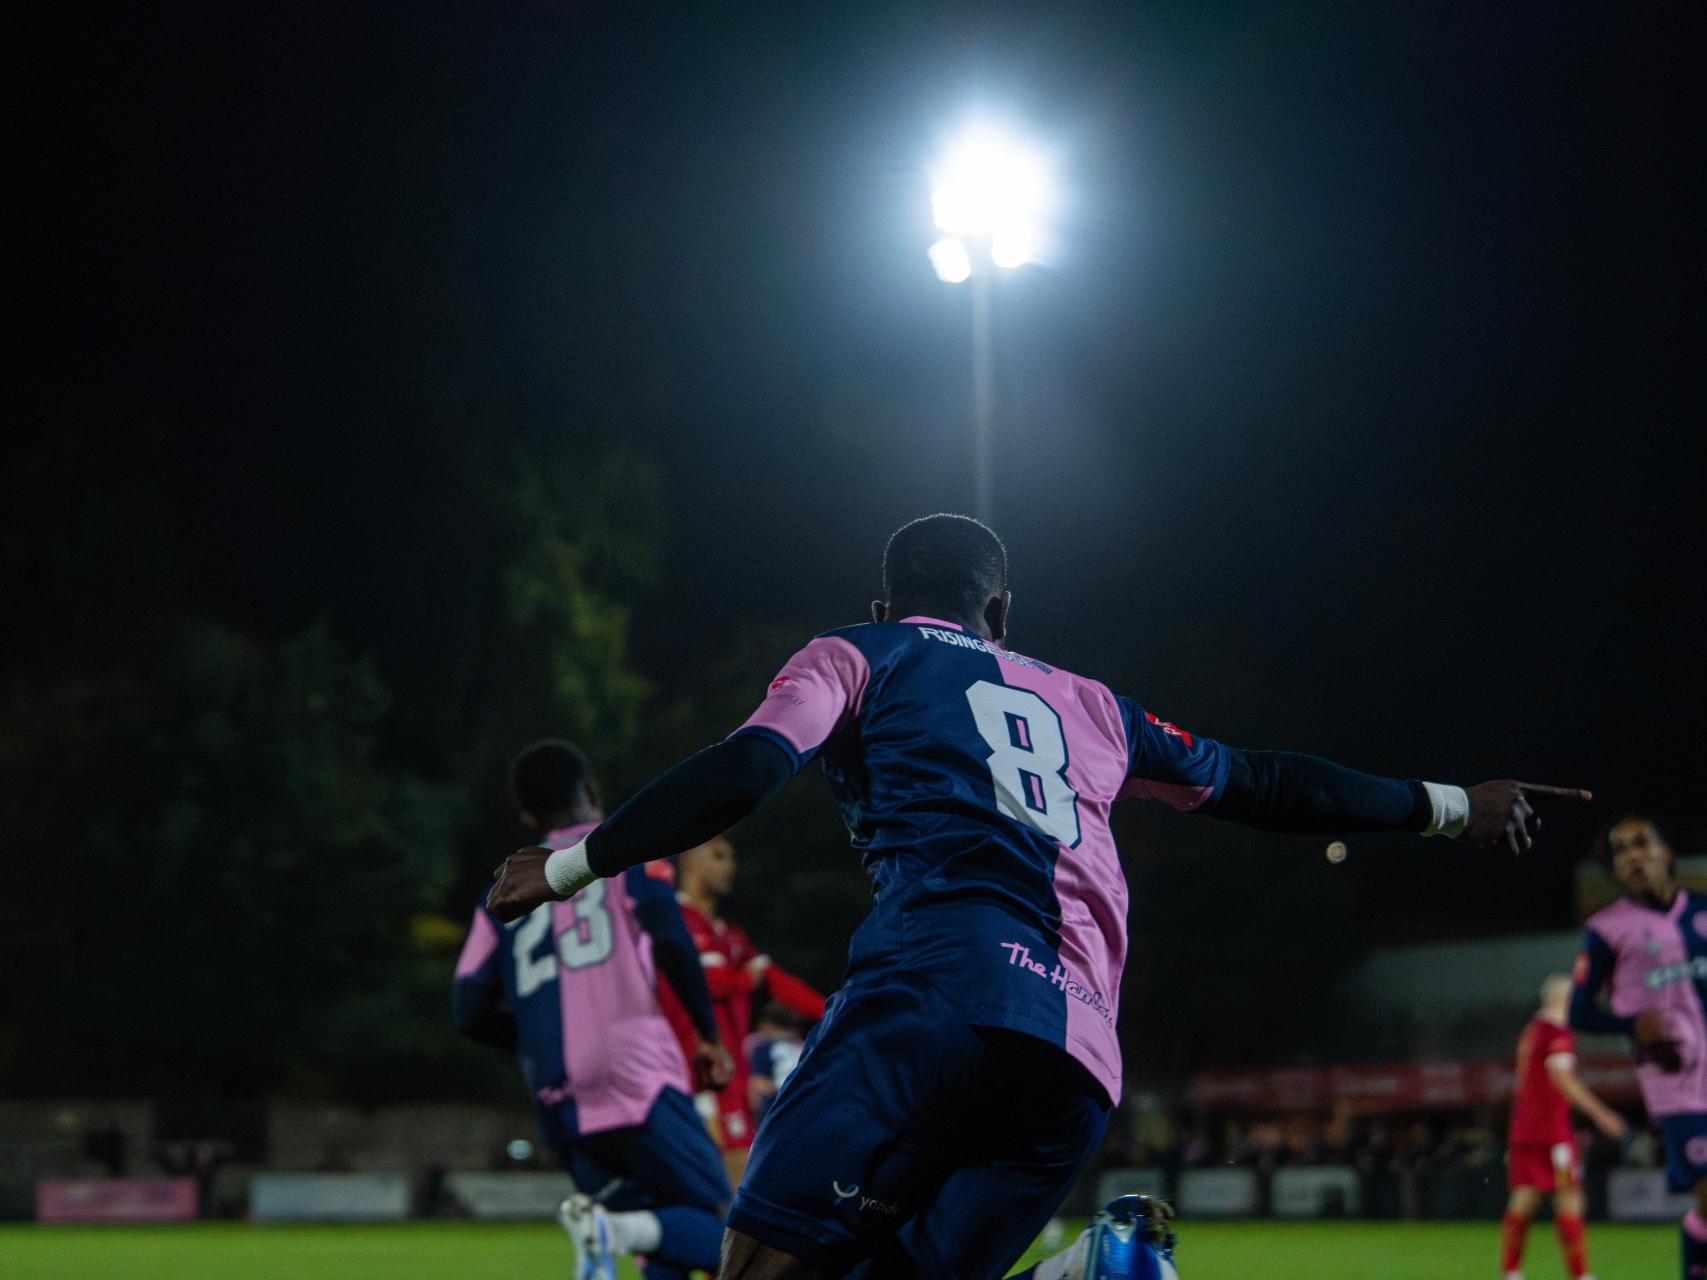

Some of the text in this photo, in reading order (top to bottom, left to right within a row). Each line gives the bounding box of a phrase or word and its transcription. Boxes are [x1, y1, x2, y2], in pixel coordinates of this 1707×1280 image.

[965, 679, 1081, 850] 8
[503, 876, 614, 998] 23
[1000, 942, 1047, 978] The
